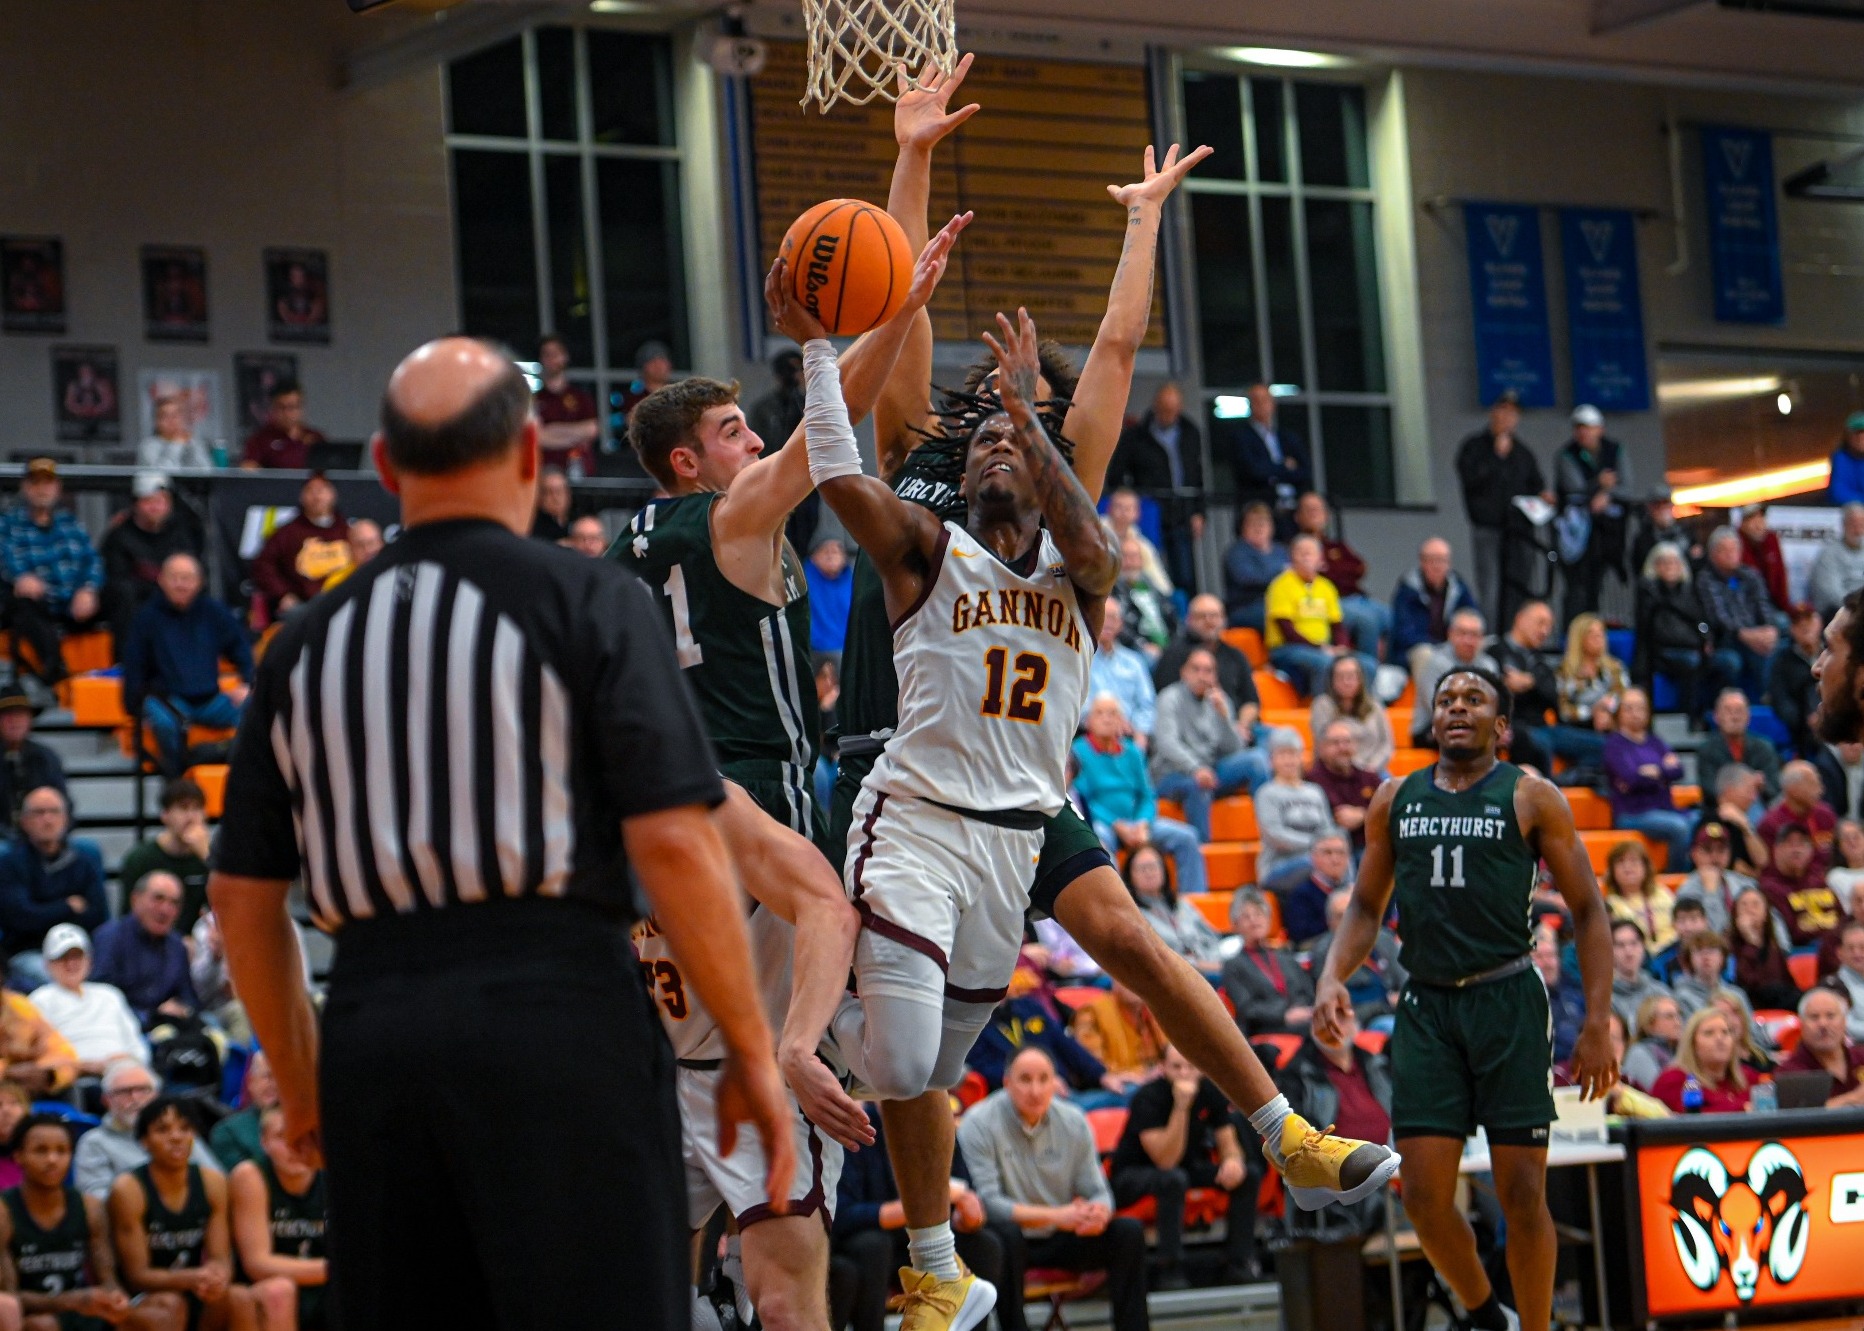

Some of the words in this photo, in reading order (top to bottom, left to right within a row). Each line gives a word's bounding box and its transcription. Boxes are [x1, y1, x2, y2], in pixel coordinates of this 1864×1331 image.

[952, 589, 1080, 653] GANNON
[980, 645, 1050, 725] 12
[1399, 816, 1506, 840] MERCYHURST
[1430, 844, 1466, 888] 11
